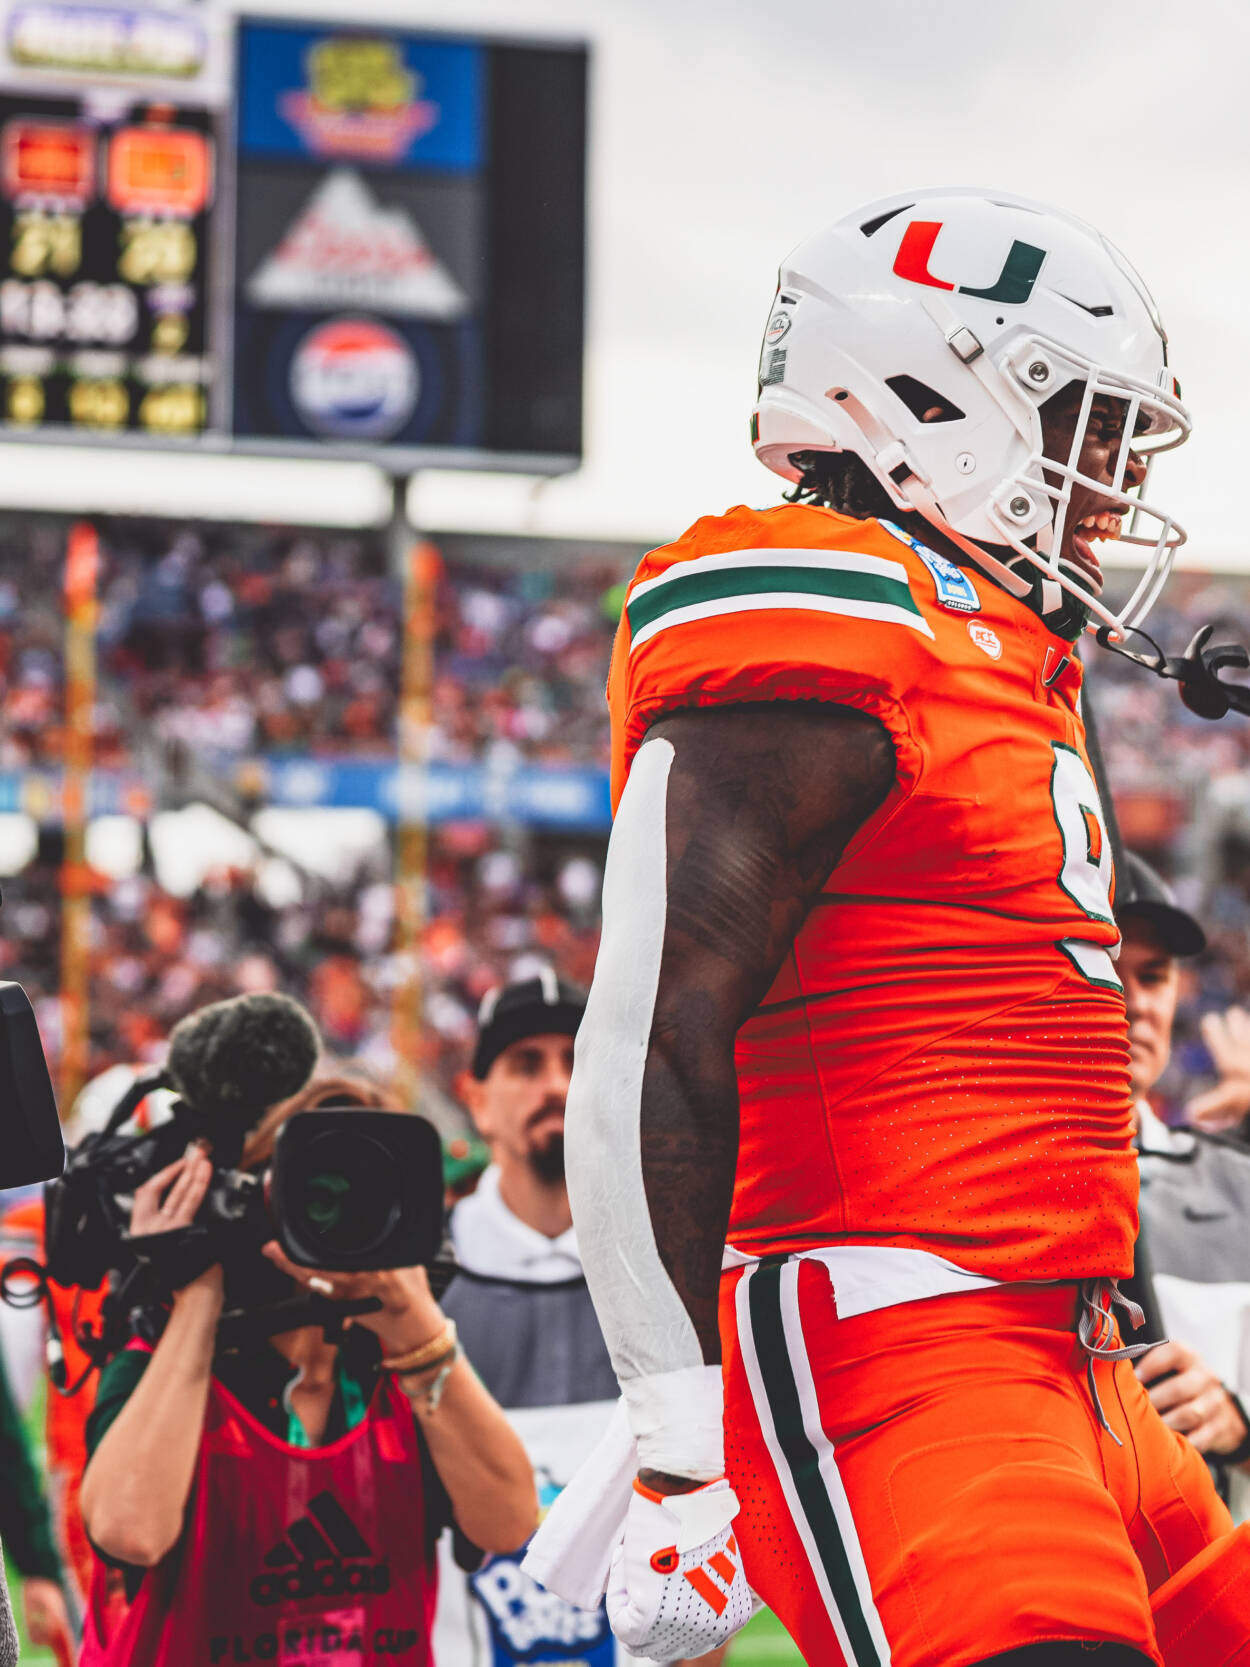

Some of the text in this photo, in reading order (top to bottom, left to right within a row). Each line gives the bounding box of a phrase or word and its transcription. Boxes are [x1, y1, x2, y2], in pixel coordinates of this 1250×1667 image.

[893, 221, 1047, 304] U
[1050, 740, 1124, 992] 9
[251, 1556, 390, 1607] adidas
[210, 1626, 418, 1665] FLORIDA CUP
